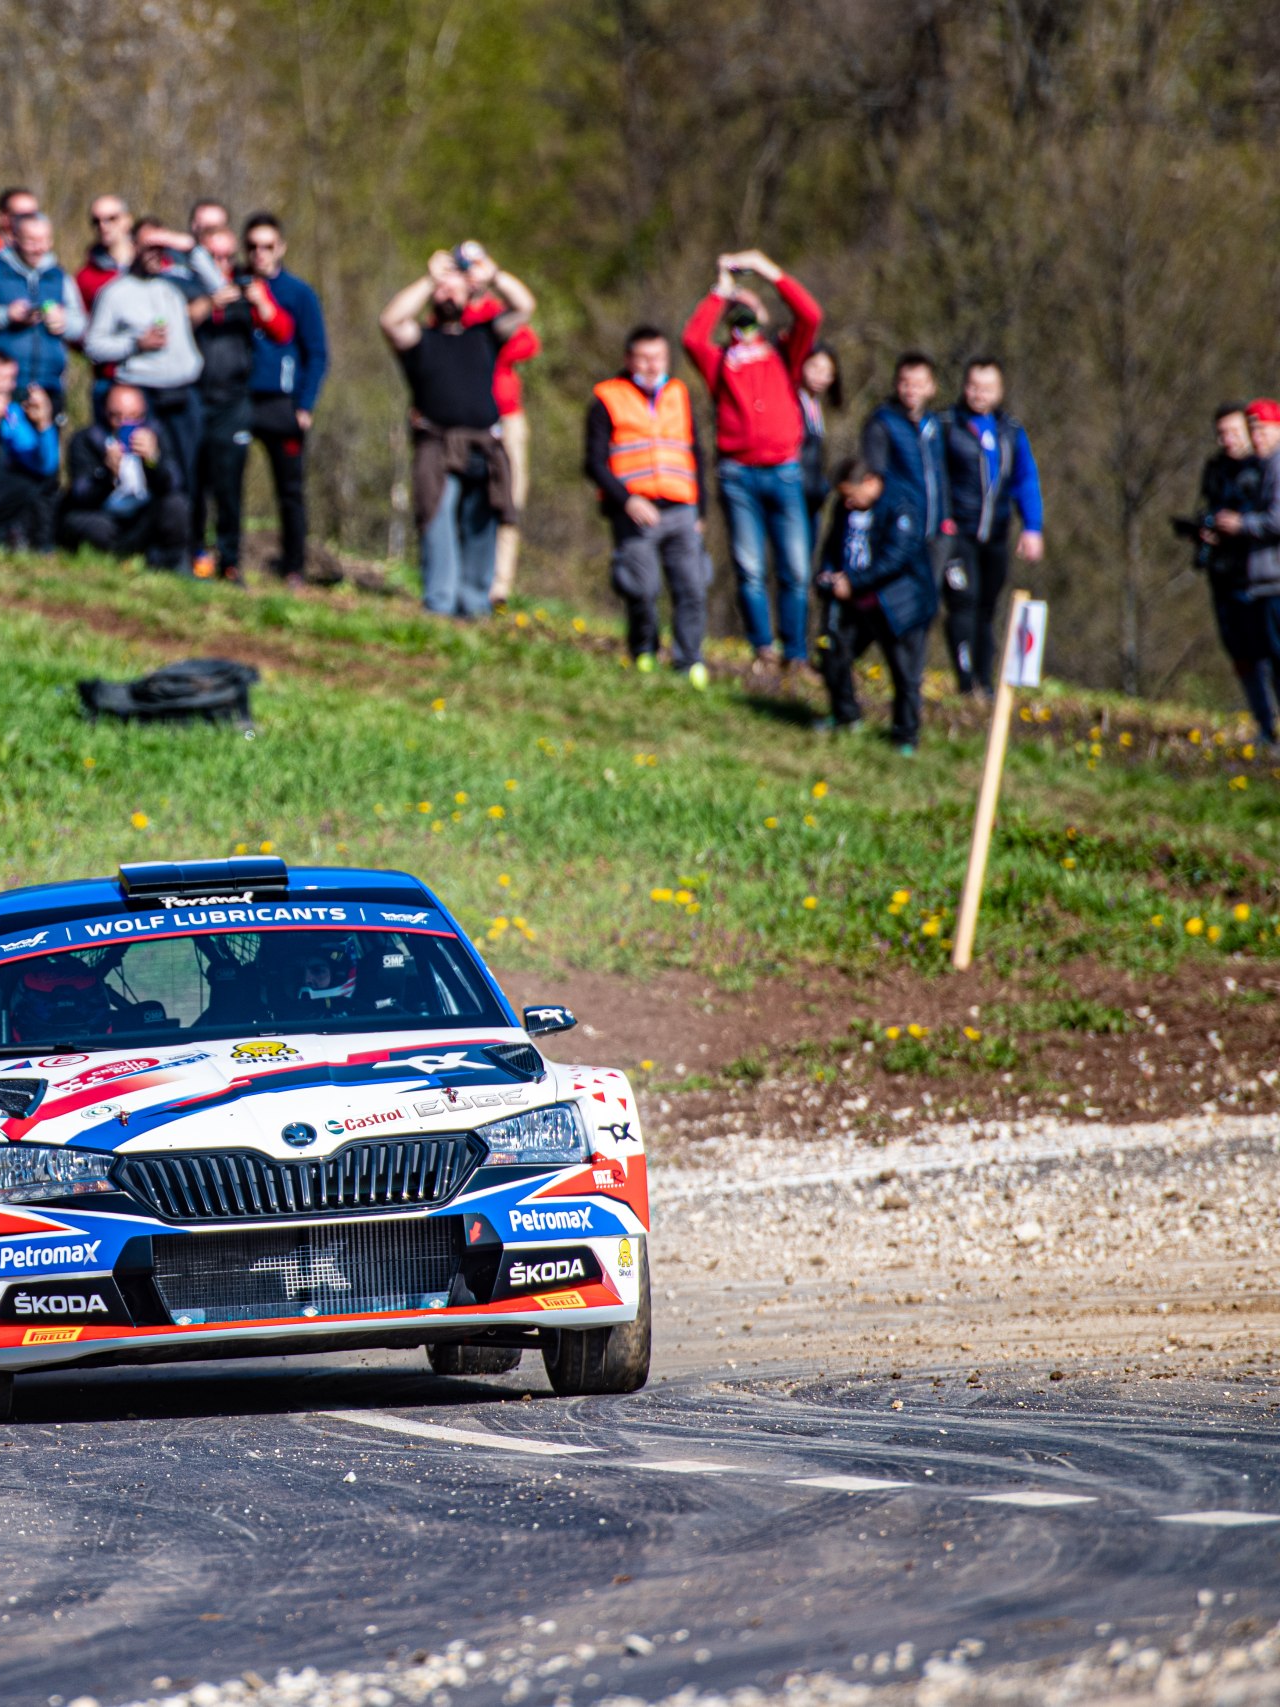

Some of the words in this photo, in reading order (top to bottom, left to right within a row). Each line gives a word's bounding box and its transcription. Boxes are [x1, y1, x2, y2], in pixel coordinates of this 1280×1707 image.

[159, 891, 254, 909] Personal
[85, 915, 165, 937] WOLF
[173, 907, 347, 927] LUBRICANTS
[344, 1108, 405, 1131] Castrol
[412, 1088, 530, 1118] EDGE
[509, 1258, 585, 1286] ŠKODA
[13, 1292, 109, 1315] ŠKODA
[541, 1294, 581, 1308] PIRELLI
[28, 1328, 78, 1342] PIRELLI
